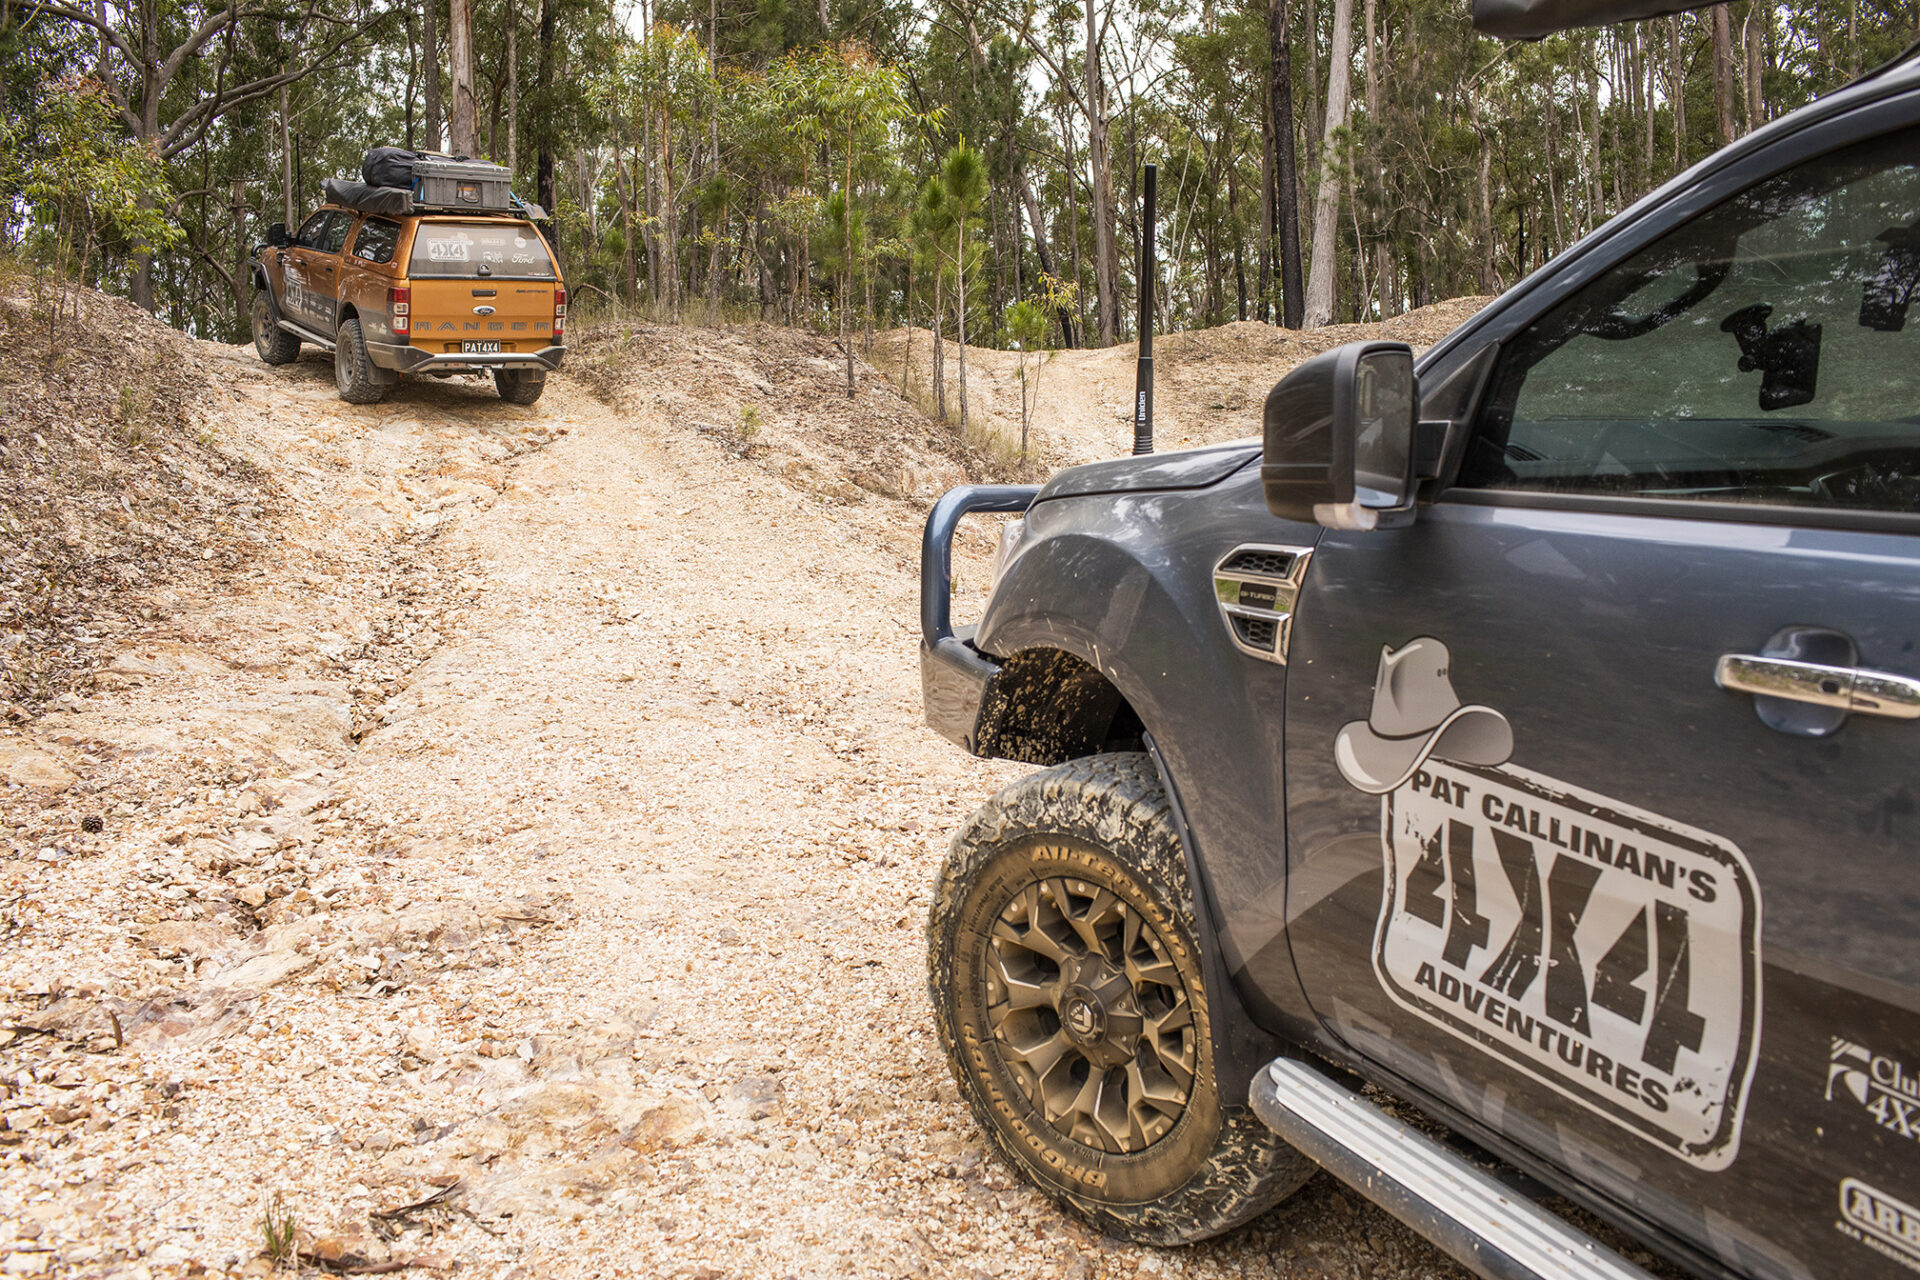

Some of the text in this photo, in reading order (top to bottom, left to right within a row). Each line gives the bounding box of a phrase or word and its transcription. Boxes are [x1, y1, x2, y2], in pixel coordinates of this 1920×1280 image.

[431, 243, 465, 257] 4X4
[511, 253, 536, 264] Ford
[413, 321, 550, 332] RANGER
[464, 342, 498, 352] PAT4X4
[1138, 391, 1146, 421] Uniden
[1411, 768, 1717, 903] PAT CALLINAN'S
[1403, 818, 1706, 1076] 4X4
[1414, 961, 1670, 1114] ADVENTURES
[1870, 1056, 1920, 1098] Clu
